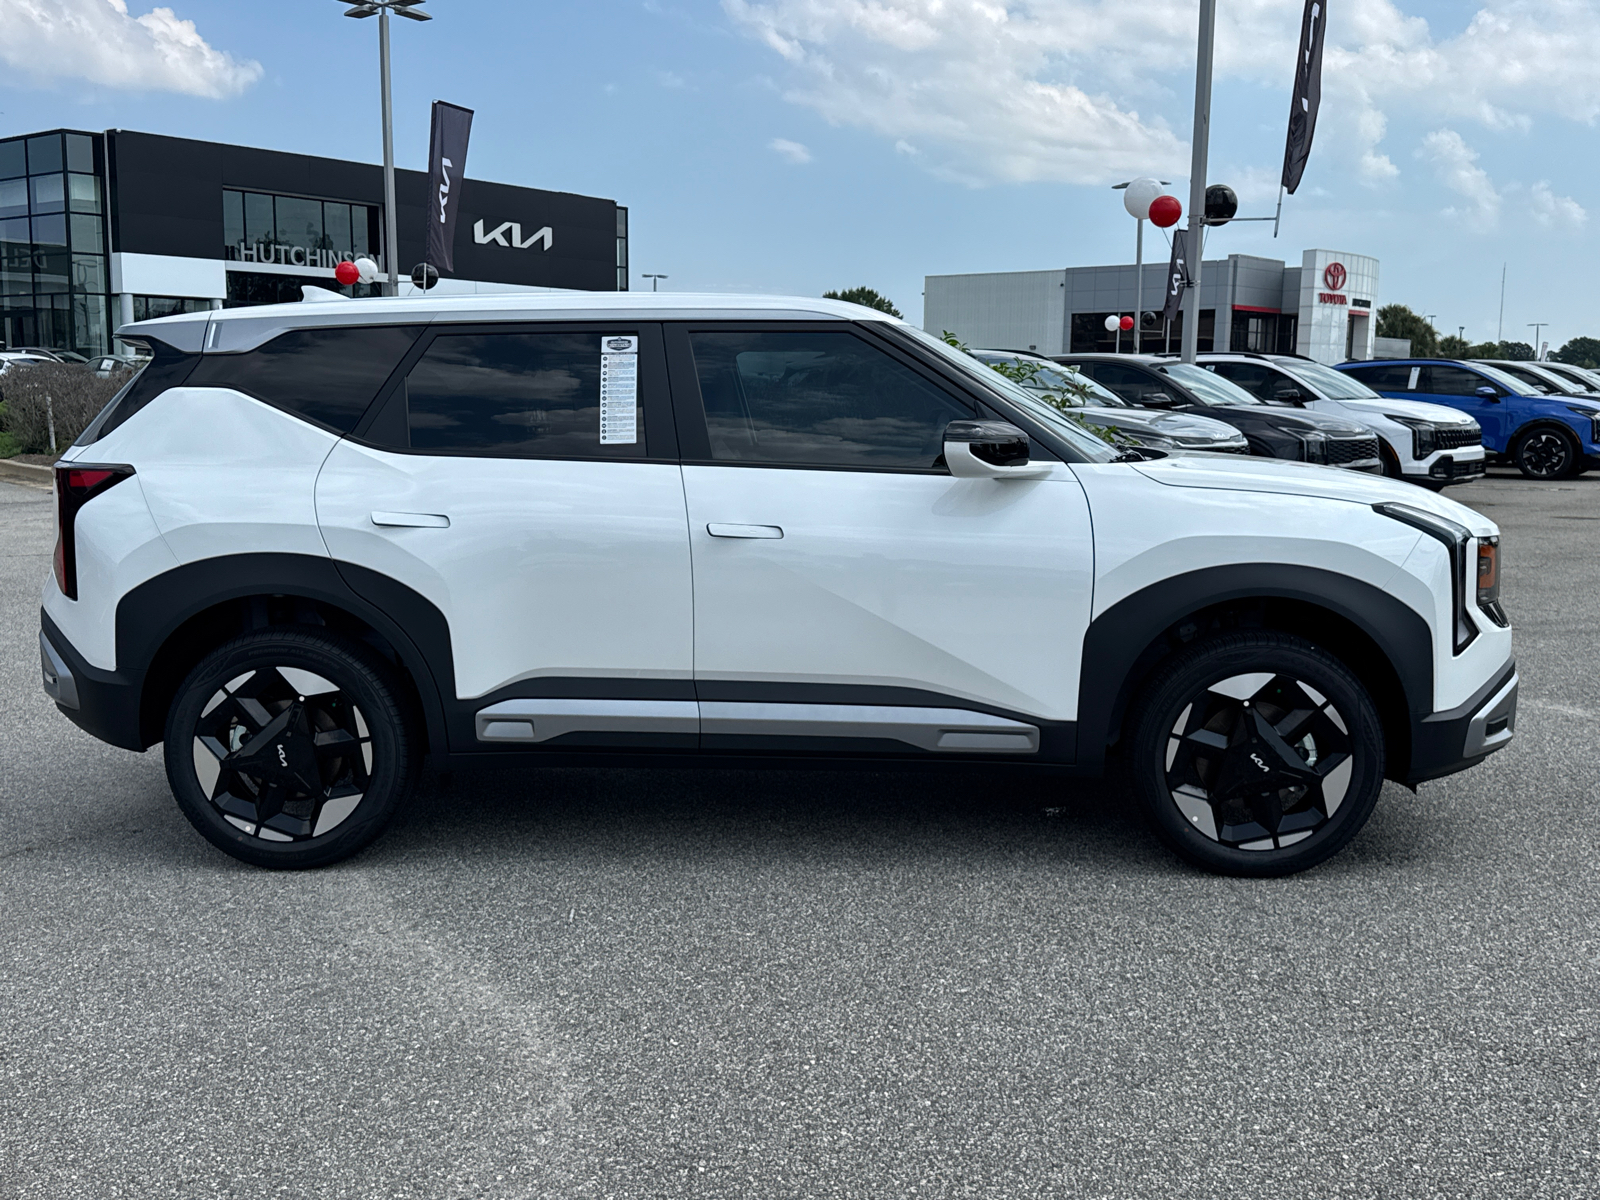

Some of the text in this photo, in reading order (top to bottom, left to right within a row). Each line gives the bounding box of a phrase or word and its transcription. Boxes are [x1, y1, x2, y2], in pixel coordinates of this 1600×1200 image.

[439, 157, 453, 223] KIA
[473, 218, 553, 251] KIA
[1318, 292, 1348, 305] TOYOTA
[276, 744, 288, 767] KIA
[1250, 752, 1270, 773] KIA
